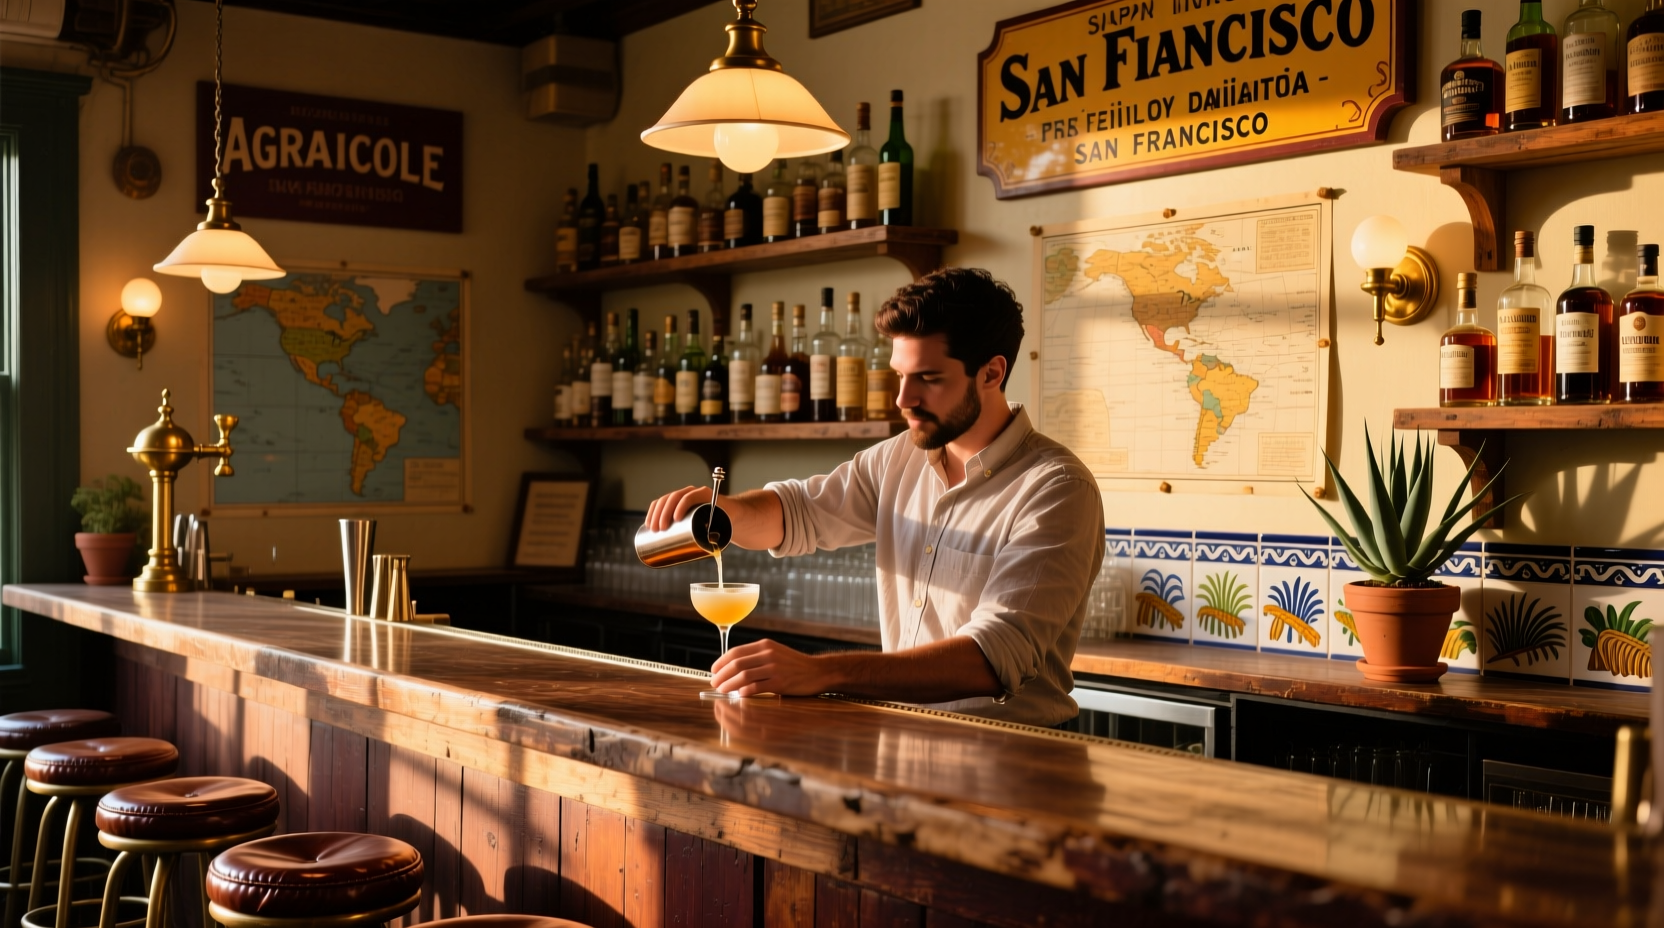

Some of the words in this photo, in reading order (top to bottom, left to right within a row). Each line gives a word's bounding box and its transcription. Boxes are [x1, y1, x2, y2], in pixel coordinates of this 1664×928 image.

[1000, 53, 1088, 122] SAN
[1102, 0, 1375, 91] FIANCISCO
[222, 116, 445, 193] AGRAICOLE
[1074, 137, 1118, 165] SAN
[1133, 111, 1269, 156] FRANCISCO
